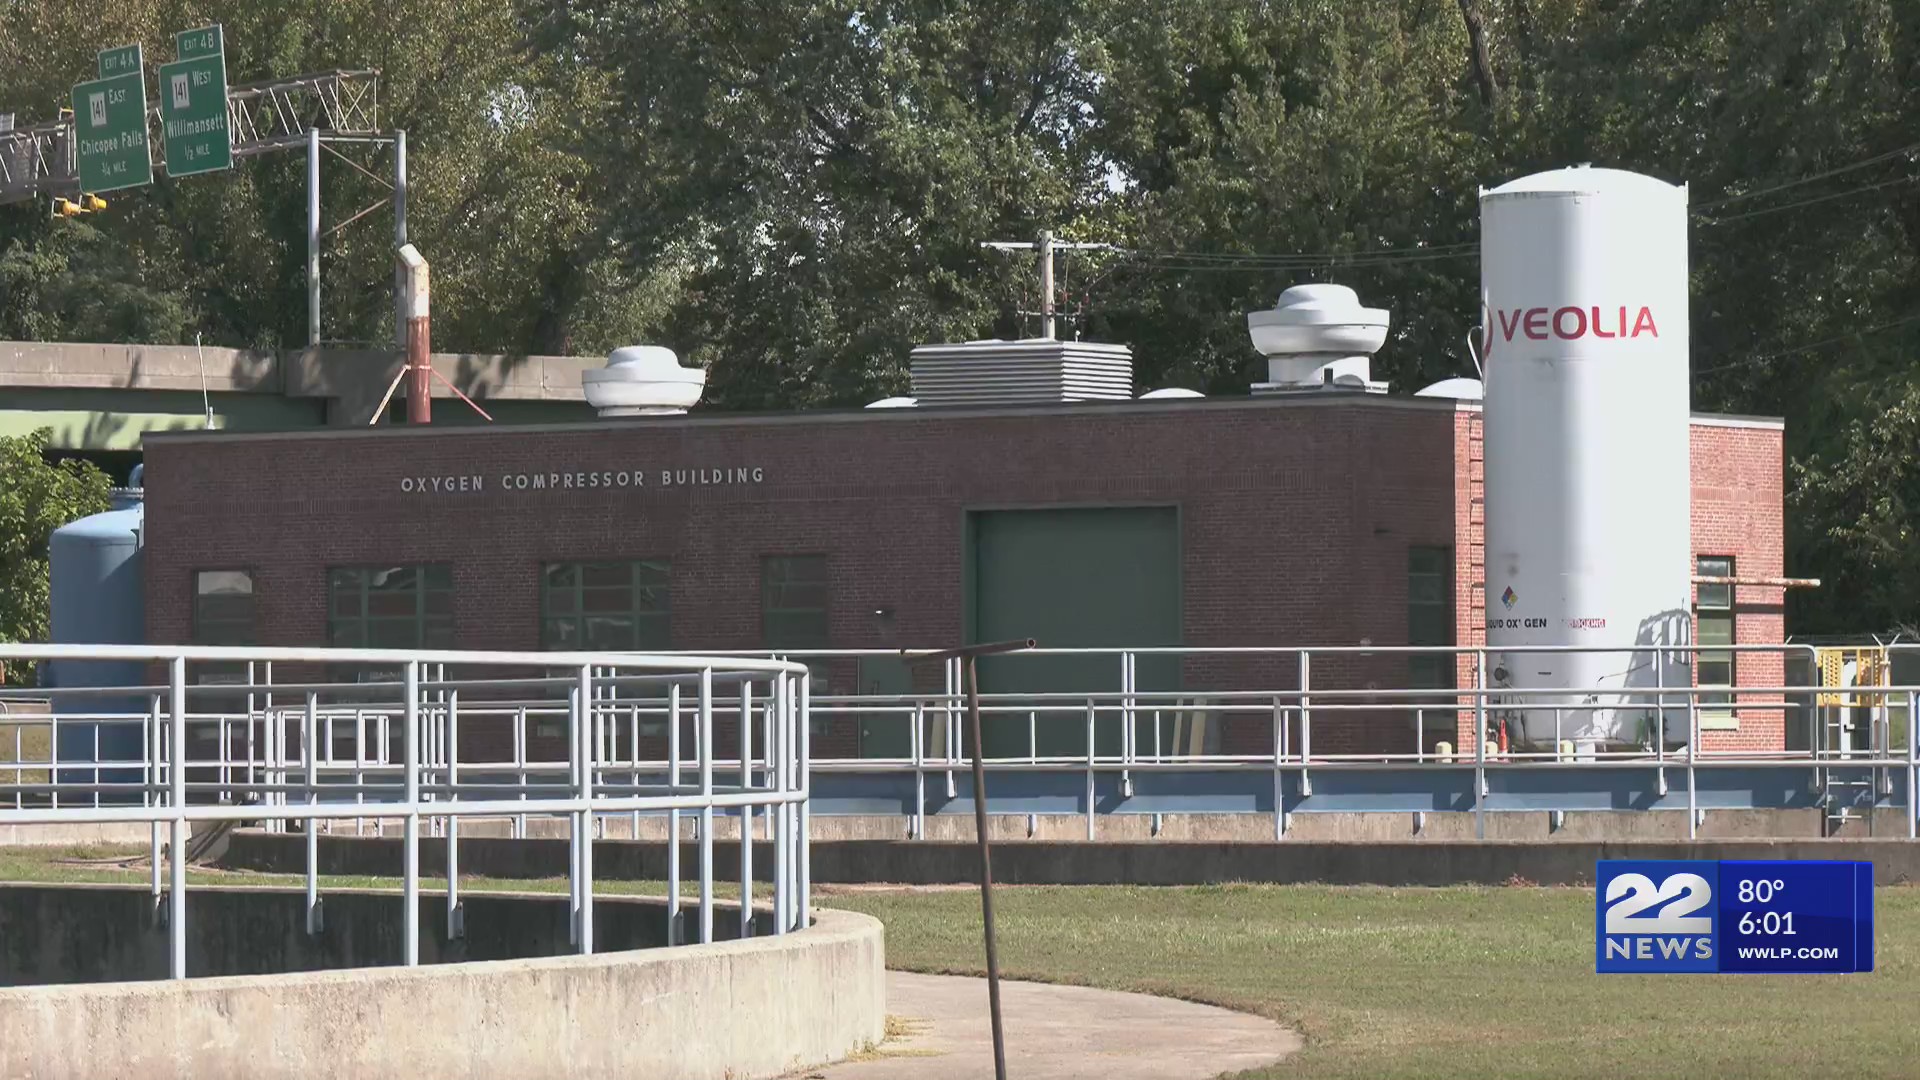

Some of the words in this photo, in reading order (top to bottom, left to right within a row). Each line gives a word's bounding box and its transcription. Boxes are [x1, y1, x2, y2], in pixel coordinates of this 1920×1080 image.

[184, 38, 197, 51] EXIT
[105, 56, 117, 70] EXIT
[174, 81, 187, 101] 141
[92, 99, 105, 119] 141
[166, 113, 224, 139] Willimansett
[81, 137, 119, 156] Chicopee
[121, 129, 143, 148] Falls
[1498, 305, 1659, 342] VEOLIA
[401, 476, 484, 493] OXYGEN
[502, 470, 644, 491] COMPRESSOR
[662, 467, 765, 486] BUILDING
[1506, 617, 1547, 629] OXGEN
